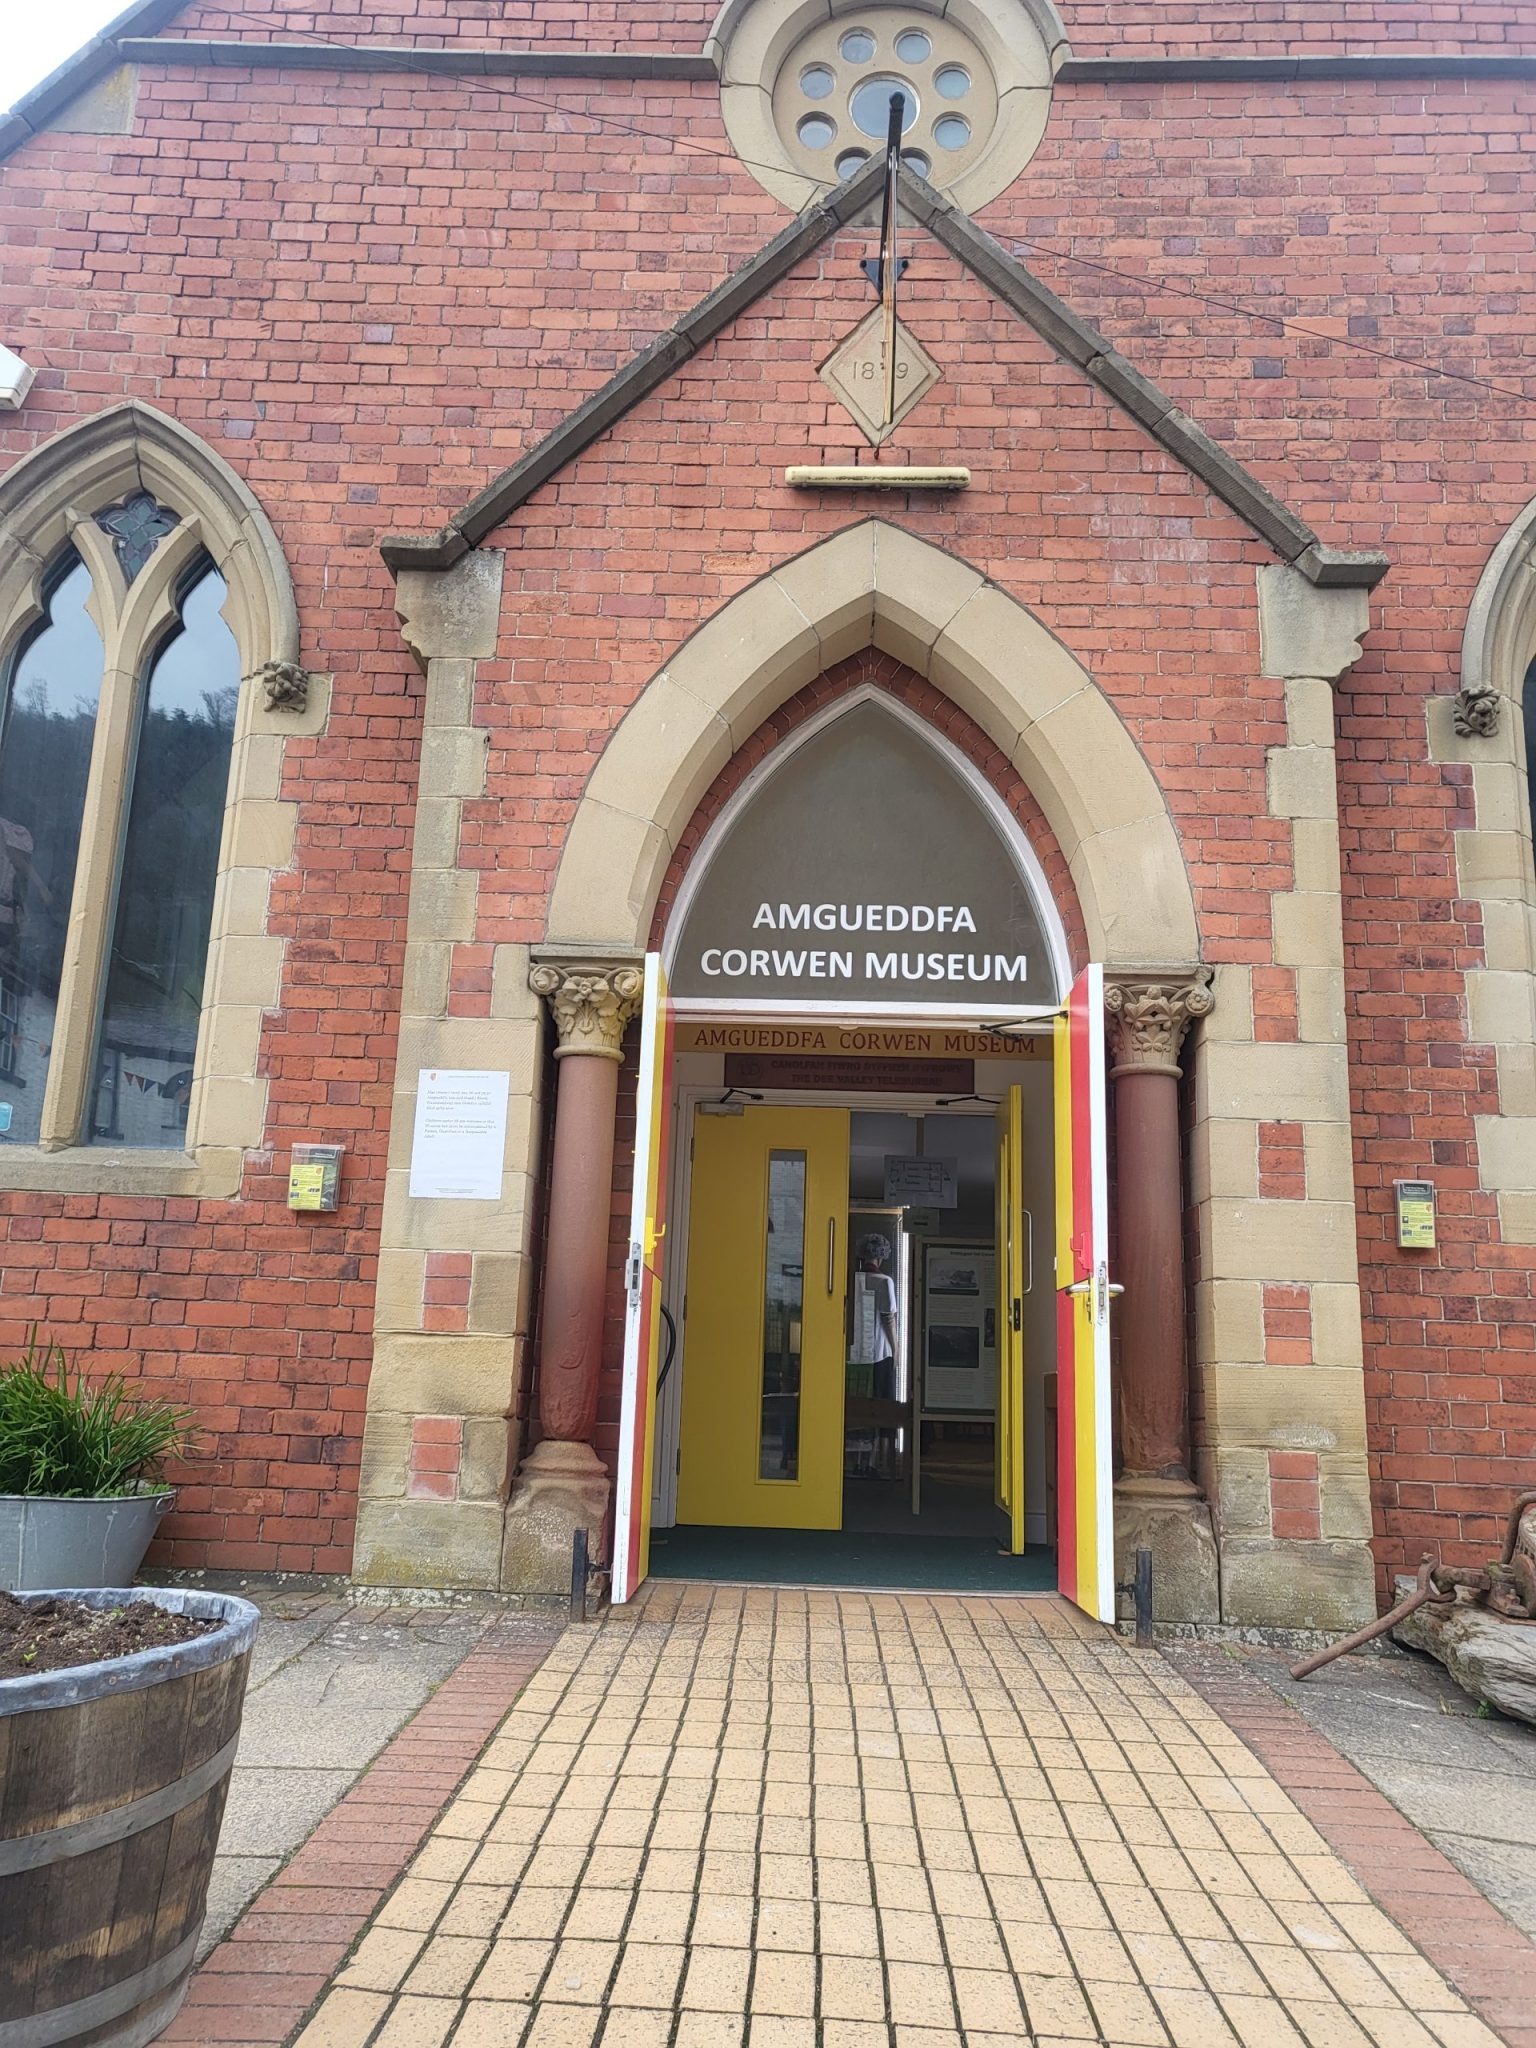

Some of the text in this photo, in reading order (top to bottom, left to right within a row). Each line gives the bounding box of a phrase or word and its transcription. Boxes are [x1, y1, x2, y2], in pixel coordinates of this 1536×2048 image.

[853, 361, 909, 381] 189
[752, 902, 977, 933] AMGUEDDFA
[700, 948, 1028, 982] CORWEN MUSEUM
[694, 1029, 1036, 1053] AMGUEDDFA CORWEN MUSEUM
[791, 1074, 811, 1083] THE
[814, 1074, 834, 1084] DEE
[837, 1075, 873, 1085] VALLEY
